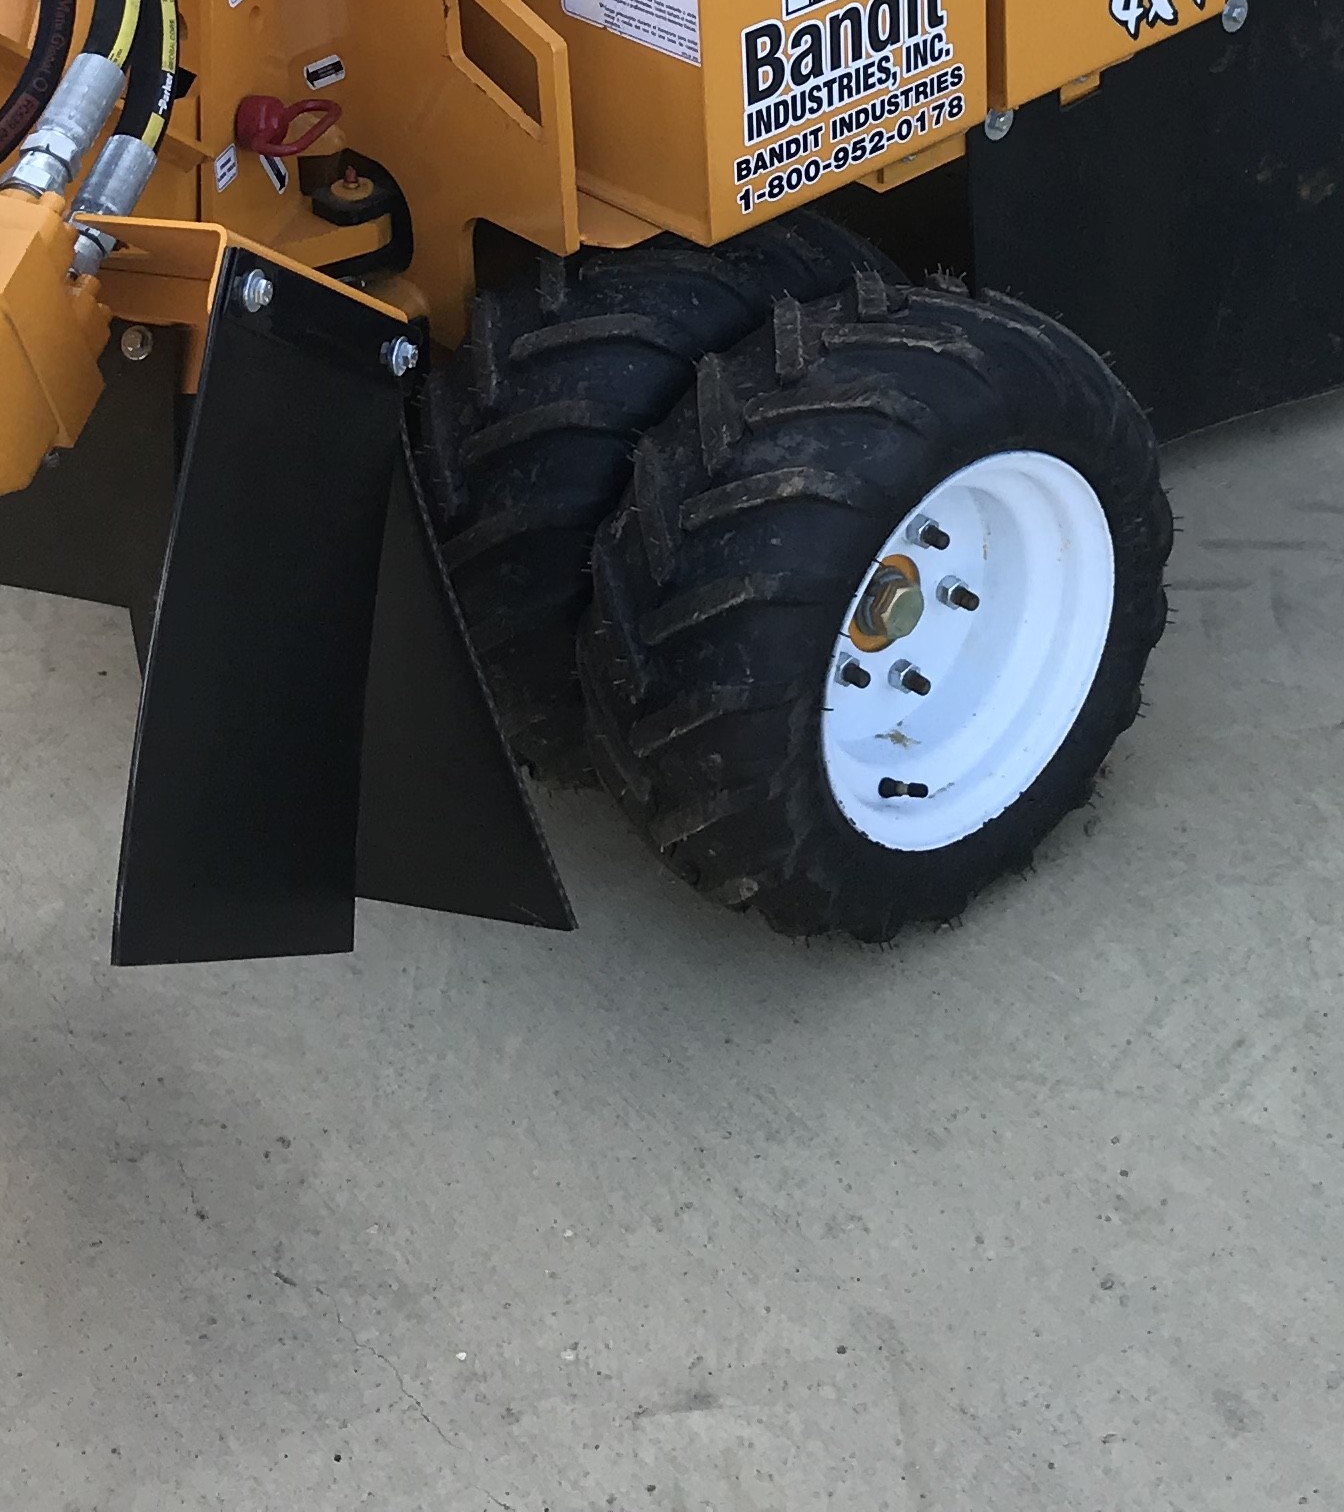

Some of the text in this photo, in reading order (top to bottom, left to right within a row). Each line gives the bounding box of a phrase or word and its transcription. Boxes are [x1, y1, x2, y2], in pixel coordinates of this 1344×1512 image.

[158, 72, 174, 114] Parker
[735, 65, 964, 182] BANDIT INDUSTRIES
[745, 34, 952, 143] INDUSTRIES, INC.
[737, 94, 965, 214] 1-800-952-0178
